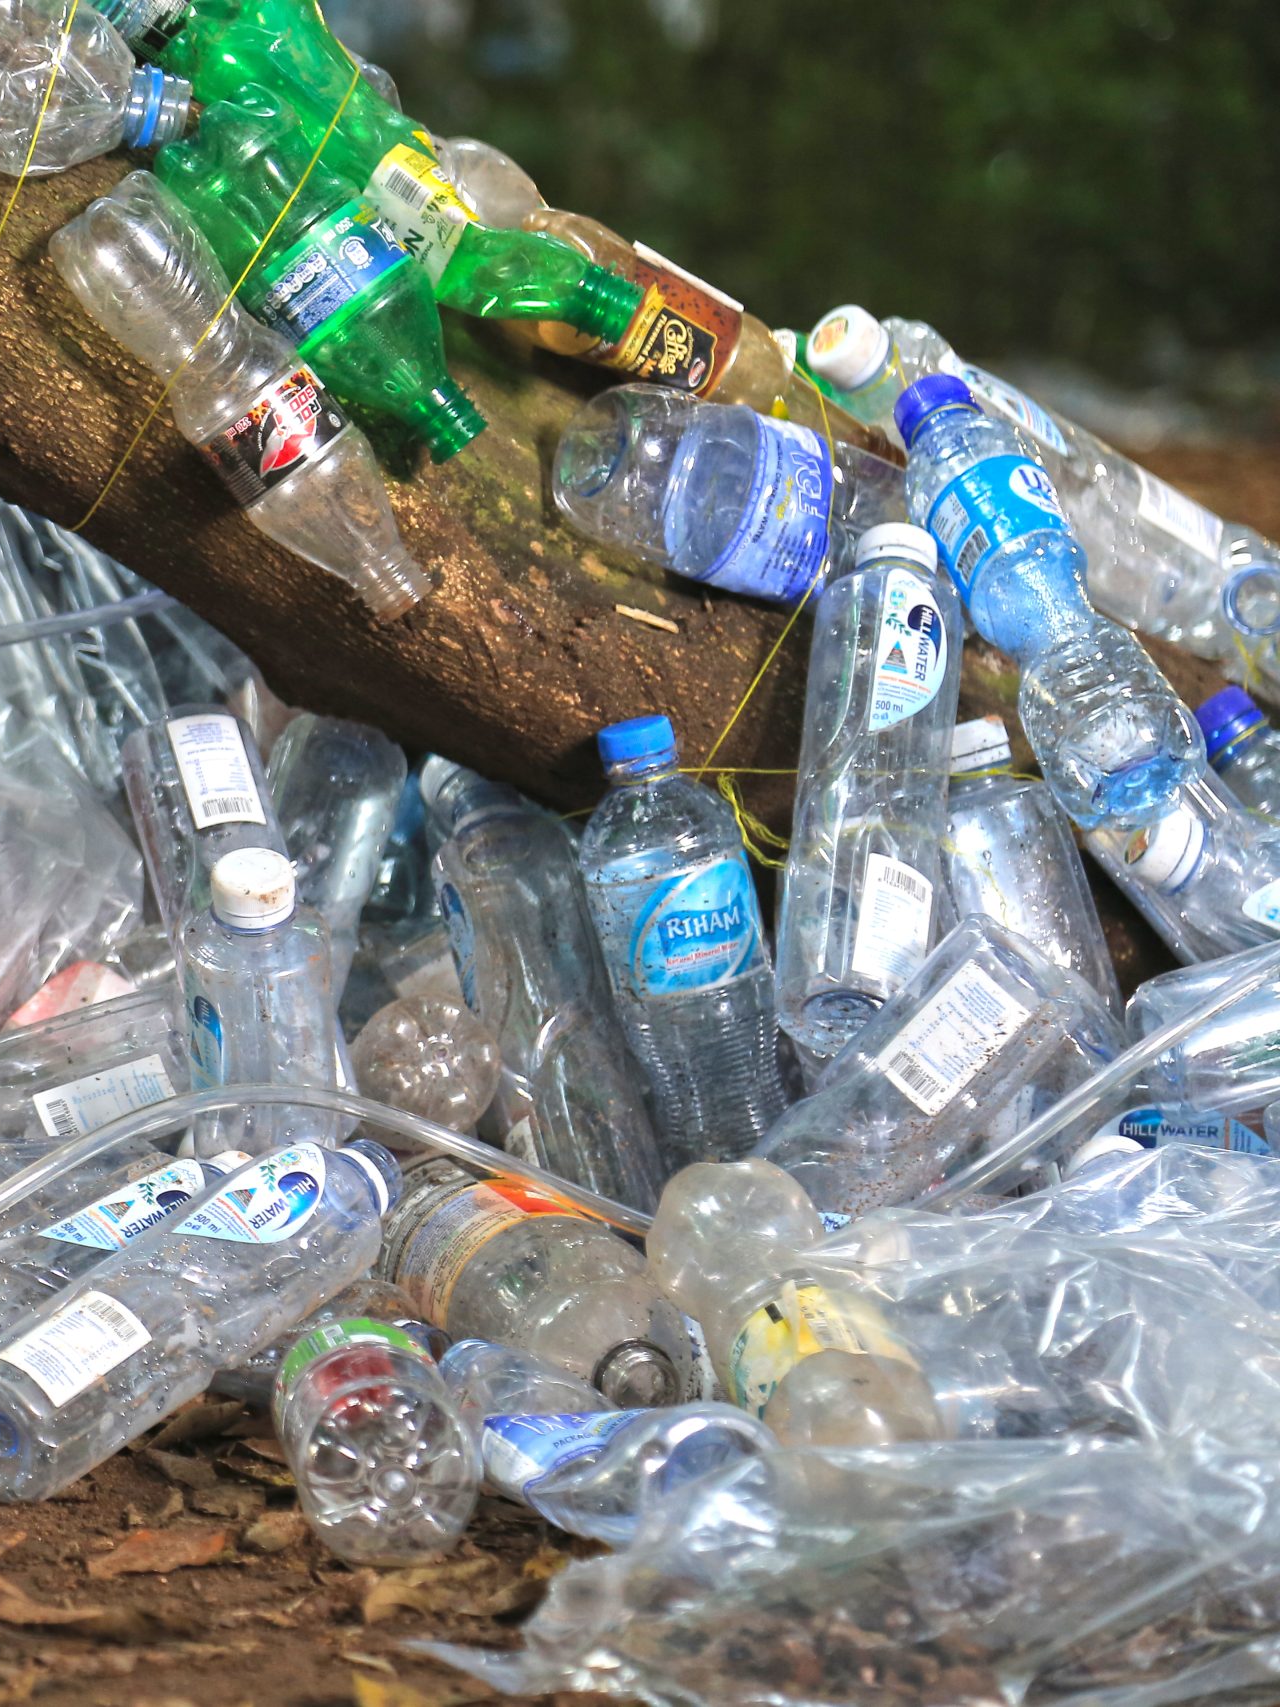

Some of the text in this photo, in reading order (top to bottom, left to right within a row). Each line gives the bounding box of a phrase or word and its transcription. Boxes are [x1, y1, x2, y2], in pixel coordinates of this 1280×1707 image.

[335, 217, 354, 235] 350
[645, 314, 668, 356] Flavoured
[658, 319, 688, 375] Coffee
[225, 416, 252, 440] 320 ml
[791, 451, 826, 520] ICE
[914, 606, 933, 682] HILL WATER
[875, 700, 903, 713] 500 ml
[666, 905, 741, 940] RIHAM
[666, 955, 694, 967] Natural
[694, 947, 721, 960] Mineral
[1123, 1123, 1219, 1138] HILL WATER
[287, 1177, 316, 1200] HILL
[120, 1209, 165, 1239] WATER
[193, 1213, 222, 1234] 500 ml
[248, 1199, 289, 1229] WATER
[60, 1222, 87, 1242] 500 ml
